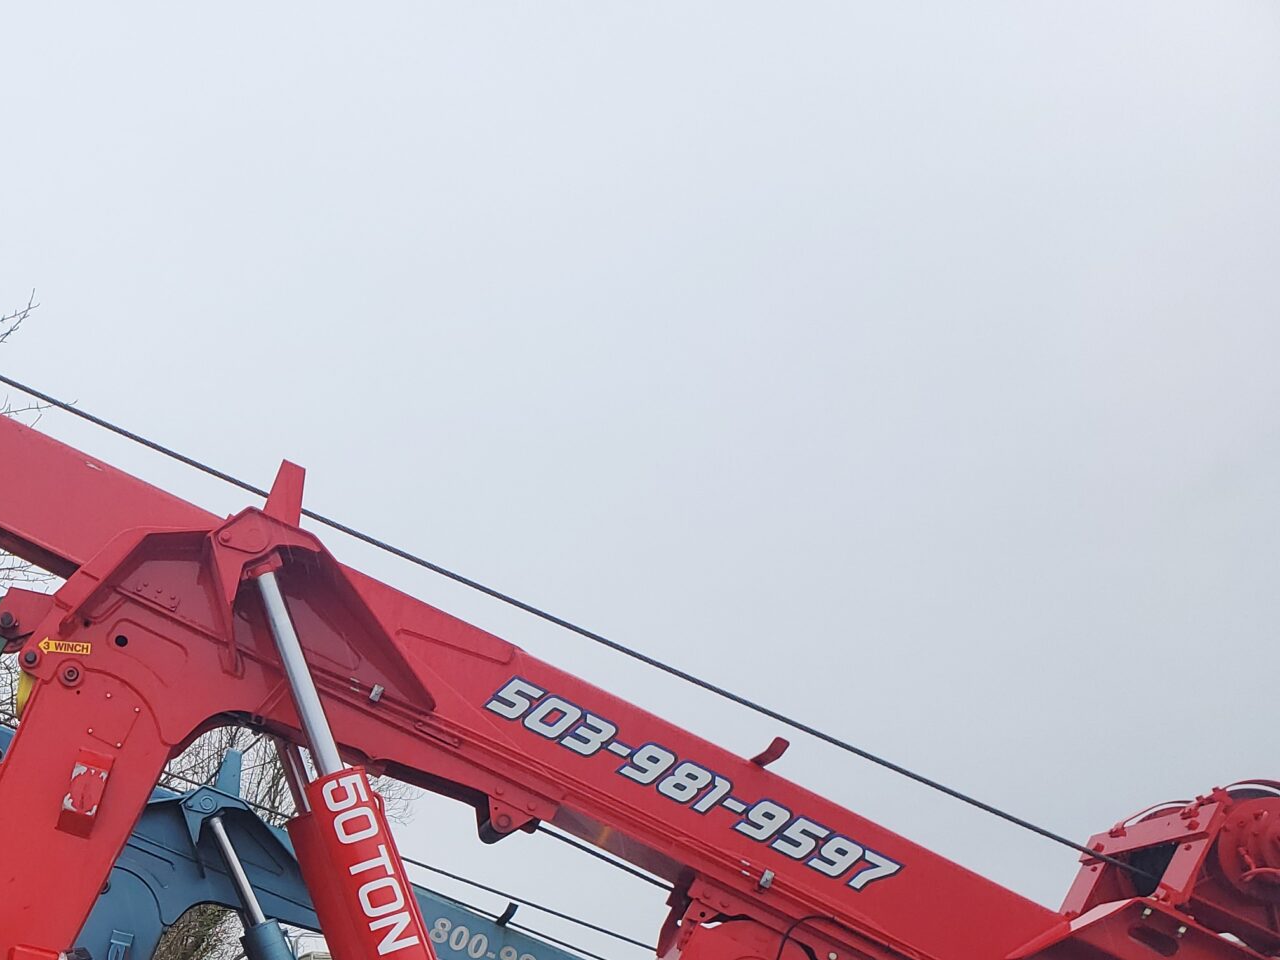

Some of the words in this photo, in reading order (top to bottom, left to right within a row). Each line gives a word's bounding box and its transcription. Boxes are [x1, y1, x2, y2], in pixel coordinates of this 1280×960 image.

[43, 641, 51, 650] 3
[55, 642, 90, 654] WINCH
[322, 773, 379, 844] 50
[484, 675, 906, 892] 503-981-9597
[348, 844, 420, 956] TON
